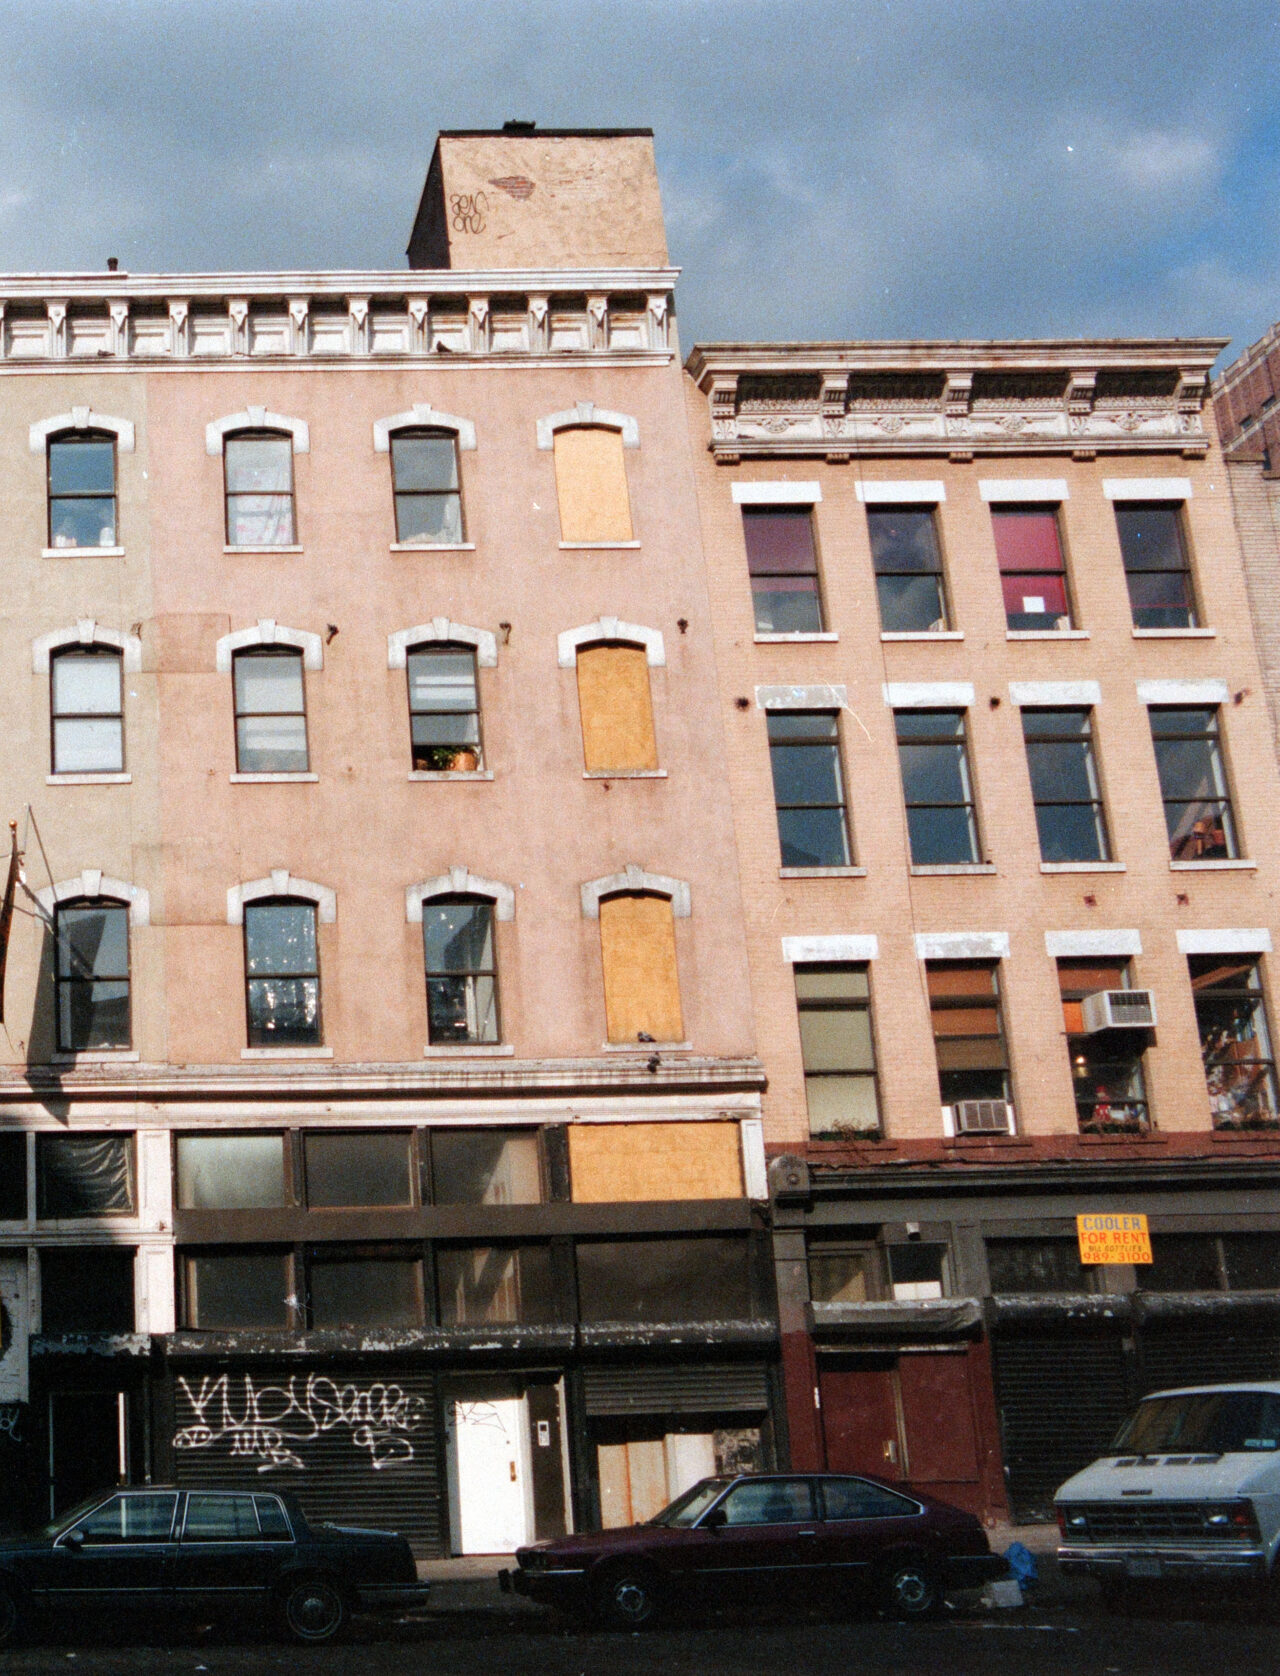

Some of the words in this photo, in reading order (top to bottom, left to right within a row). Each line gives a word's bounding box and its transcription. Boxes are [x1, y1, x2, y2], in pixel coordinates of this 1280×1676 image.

[1083, 1216, 1141, 1231] COOLER
[1080, 1231, 1107, 1245] FOR
[1113, 1231, 1147, 1245] RENT
[1083, 1251, 1150, 1262] 989-3100
